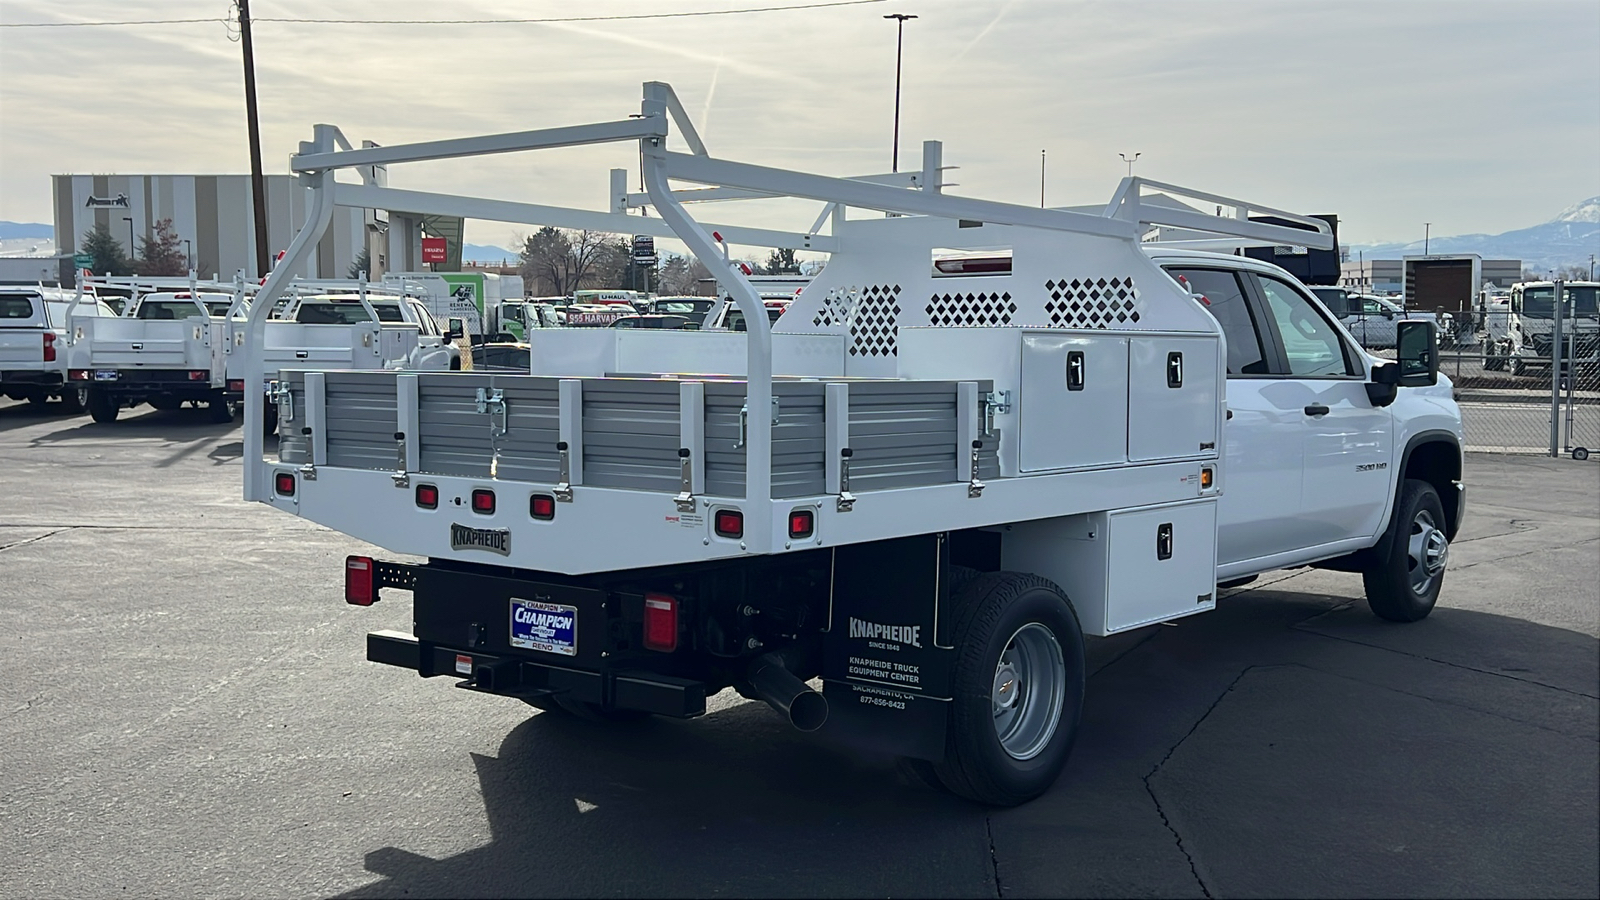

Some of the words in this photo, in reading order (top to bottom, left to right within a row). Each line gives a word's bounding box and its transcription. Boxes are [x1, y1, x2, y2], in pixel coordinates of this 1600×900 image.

[453, 528, 507, 551] KNAPHEIDE
[527, 601, 559, 612] CHAMPION
[532, 642, 553, 651] RENO
[868, 641, 886, 650] SINCE
[886, 644, 900, 652] 1848
[849, 656, 892, 670] KNAPHEIDE
[893, 662, 919, 674] TRUCK
[848, 665, 890, 678] EQUIPMENT
[890, 672, 919, 684] CENTER
[860, 695, 906, 710] 877-856-8423
